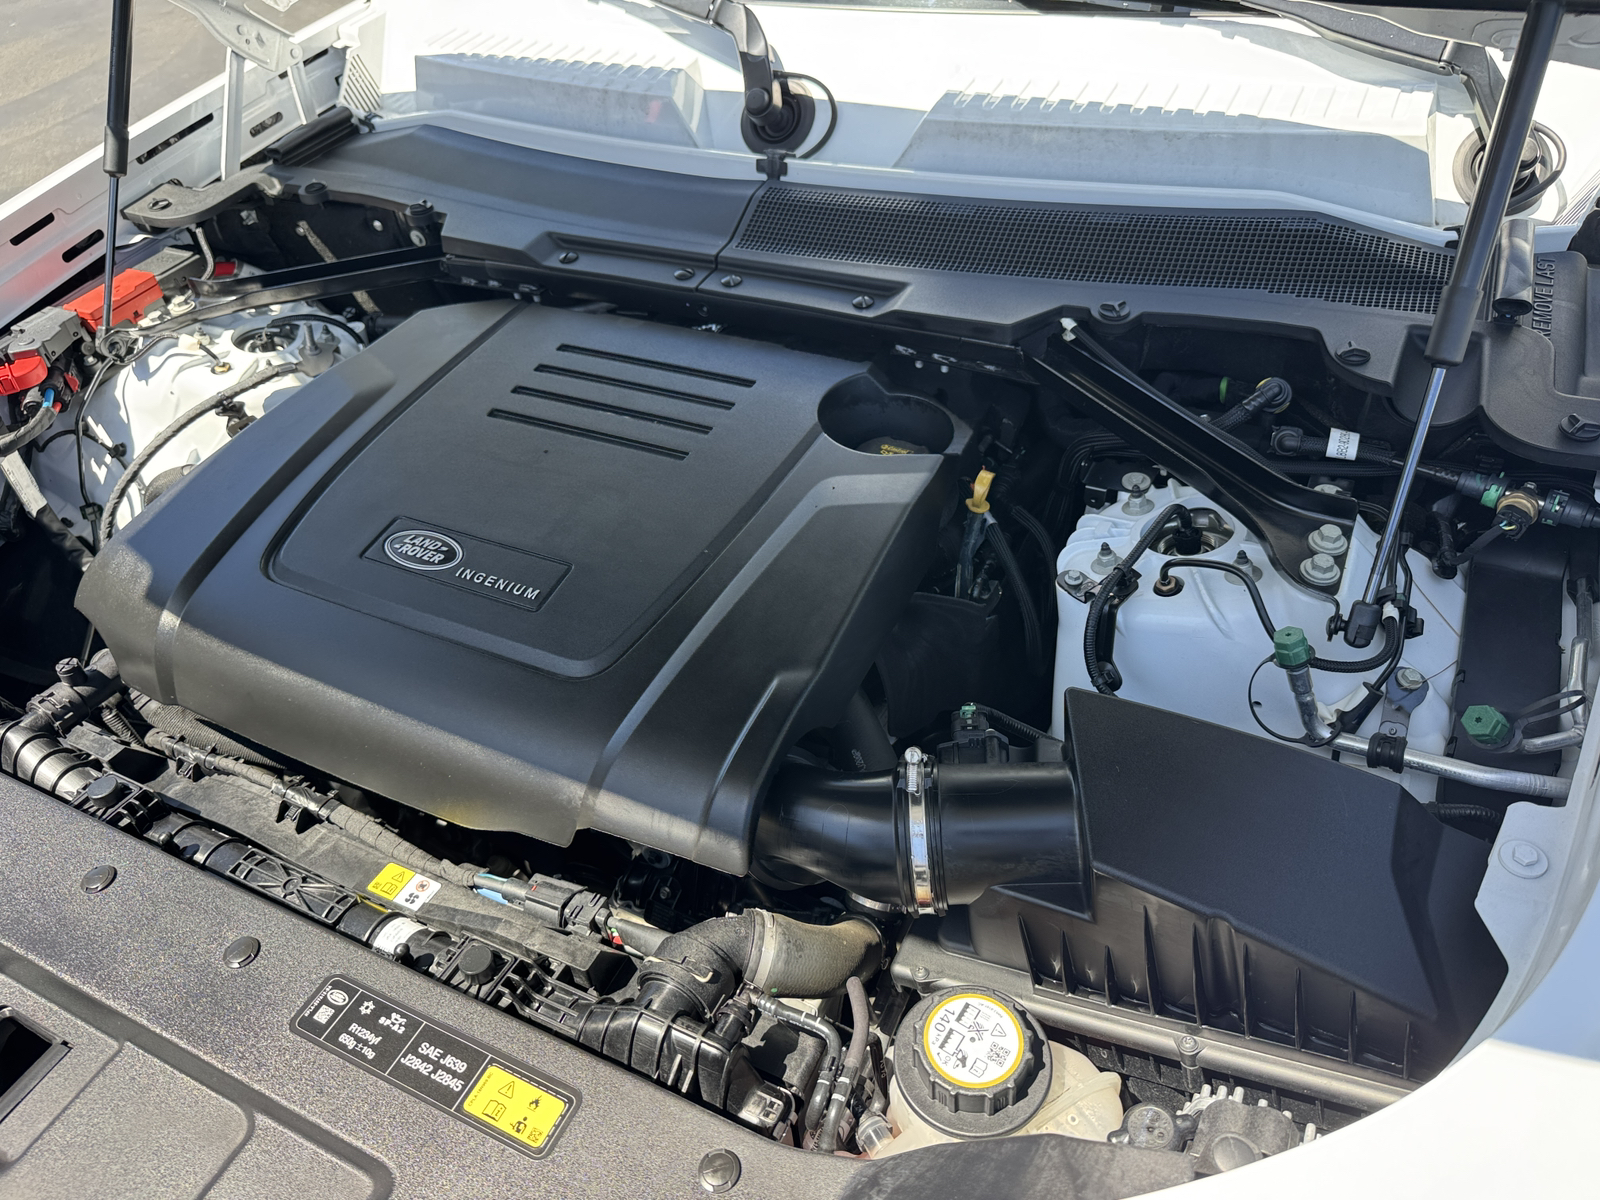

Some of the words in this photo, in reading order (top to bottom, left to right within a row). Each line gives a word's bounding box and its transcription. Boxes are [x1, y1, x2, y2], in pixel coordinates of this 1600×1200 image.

[1534, 256, 1556, 287] LAST
[397, 544, 445, 563] ROVER
[404, 535, 442, 551] LAND
[456, 567, 541, 599] INGENIUM
[378, 1016, 406, 1035] SP-A2
[934, 1009, 956, 1032] 140
[348, 1022, 383, 1046] R1234yf
[417, 1042, 444, 1061] SAE
[439, 1054, 468, 1074] J639
[942, 1055, 952, 1066] OK
[400, 1053, 434, 1076] J2842
[430, 1069, 465, 1092] J2845
